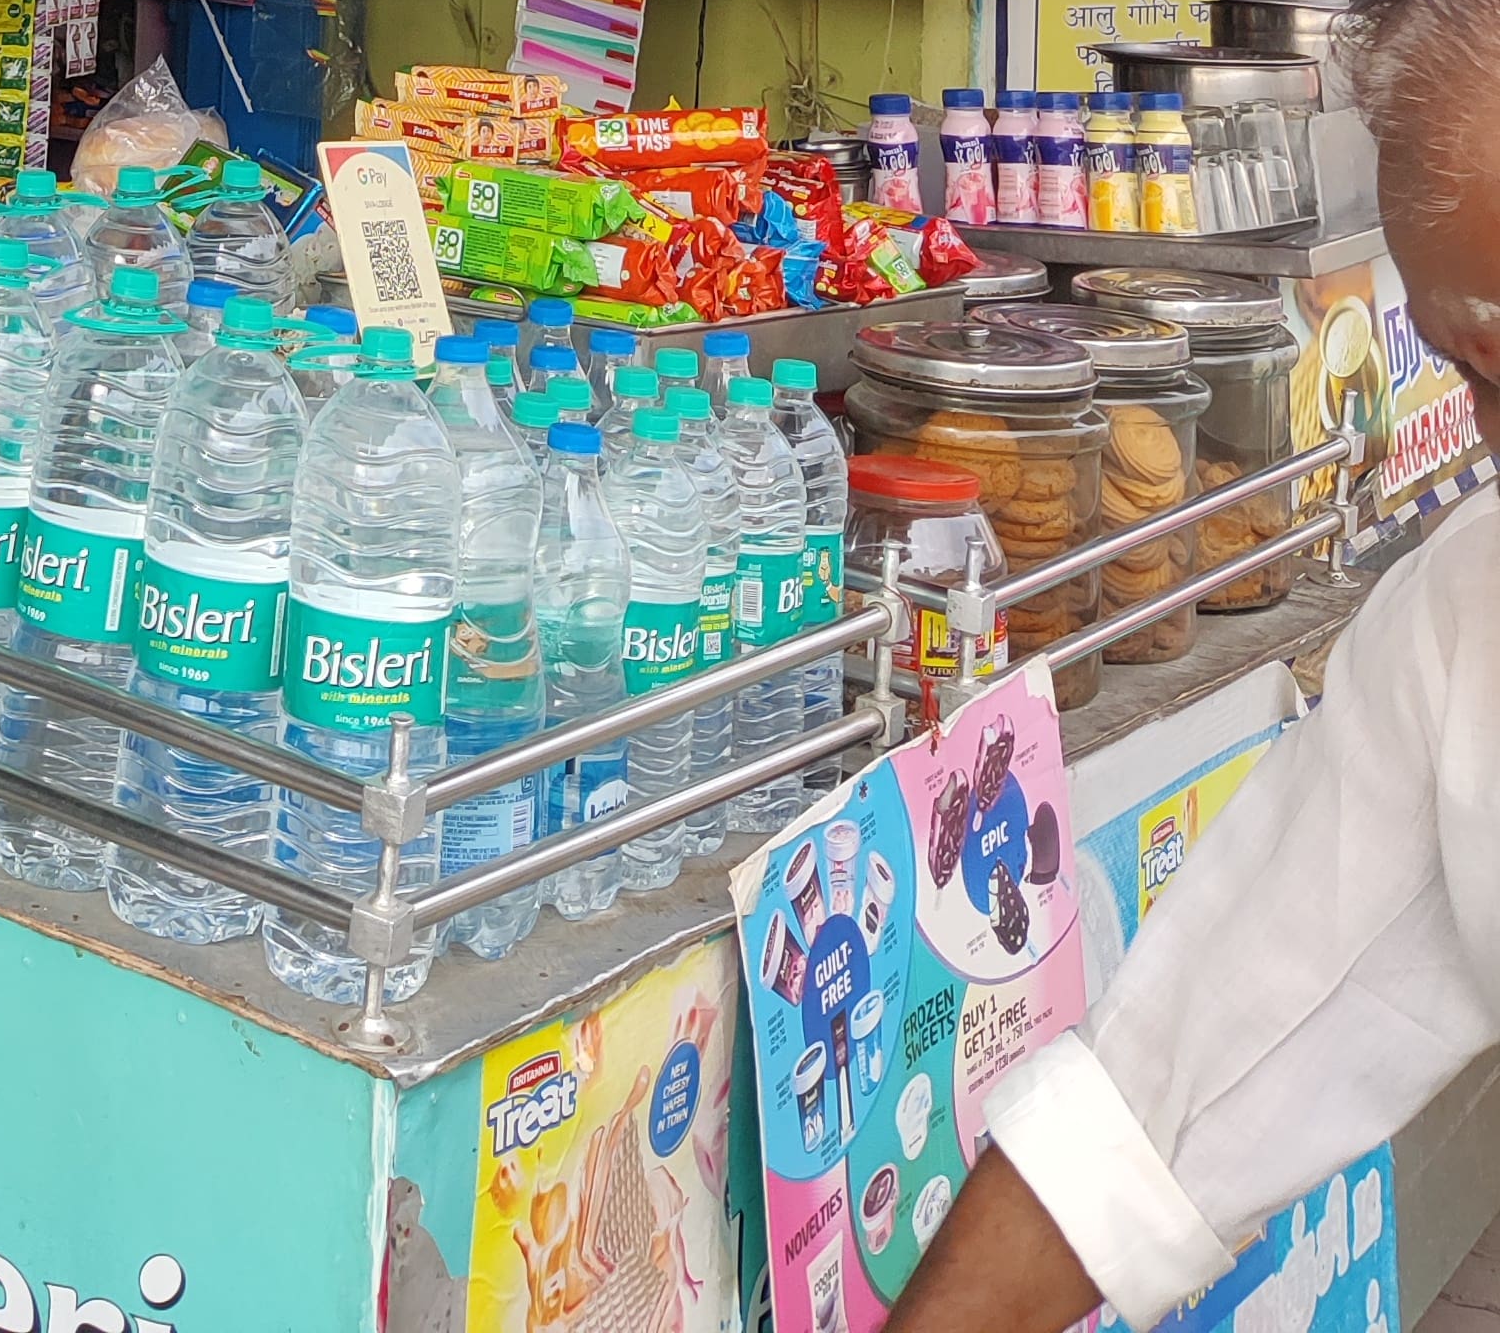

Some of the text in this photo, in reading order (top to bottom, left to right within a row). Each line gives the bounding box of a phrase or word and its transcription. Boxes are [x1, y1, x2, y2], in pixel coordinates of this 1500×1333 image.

[636, 117, 671, 134] TIME
[636, 132, 673, 154] PASS
[954, 143, 988, 164] KOOL
[955, 137, 981, 150] Amul
[878, 150, 912, 171] KOOL
[368, 169, 388, 188] Pay
[140, 582, 257, 645] Bisleri
[169, 644, 229, 661] minerals
[302, 634, 434, 690] Bisleri
[181, 665, 210, 683] 1969
[347, 691, 410, 706] minerals
[981, 819, 1009, 859] EPIC
[1141, 832, 1186, 893] Treat
[820, 973, 853, 1016] FREE
[903, 983, 955, 1046] FROZEN
[962, 999, 987, 1036] BUY
[963, 1028, 986, 1060] GET
[998, 996, 1029, 1033] FREE
[904, 1010, 956, 1071] SWEETS
[512, 1058, 556, 1091] BRITANNIA
[669, 1058, 689, 1081] NEW
[661, 1074, 692, 1101] CHEESY
[486, 1072, 578, 1159] Treat
[661, 1091, 688, 1116] WAFER
[656, 1106, 690, 1135] IN TOWN
[784, 1186, 844, 1267] NOVELTIES
